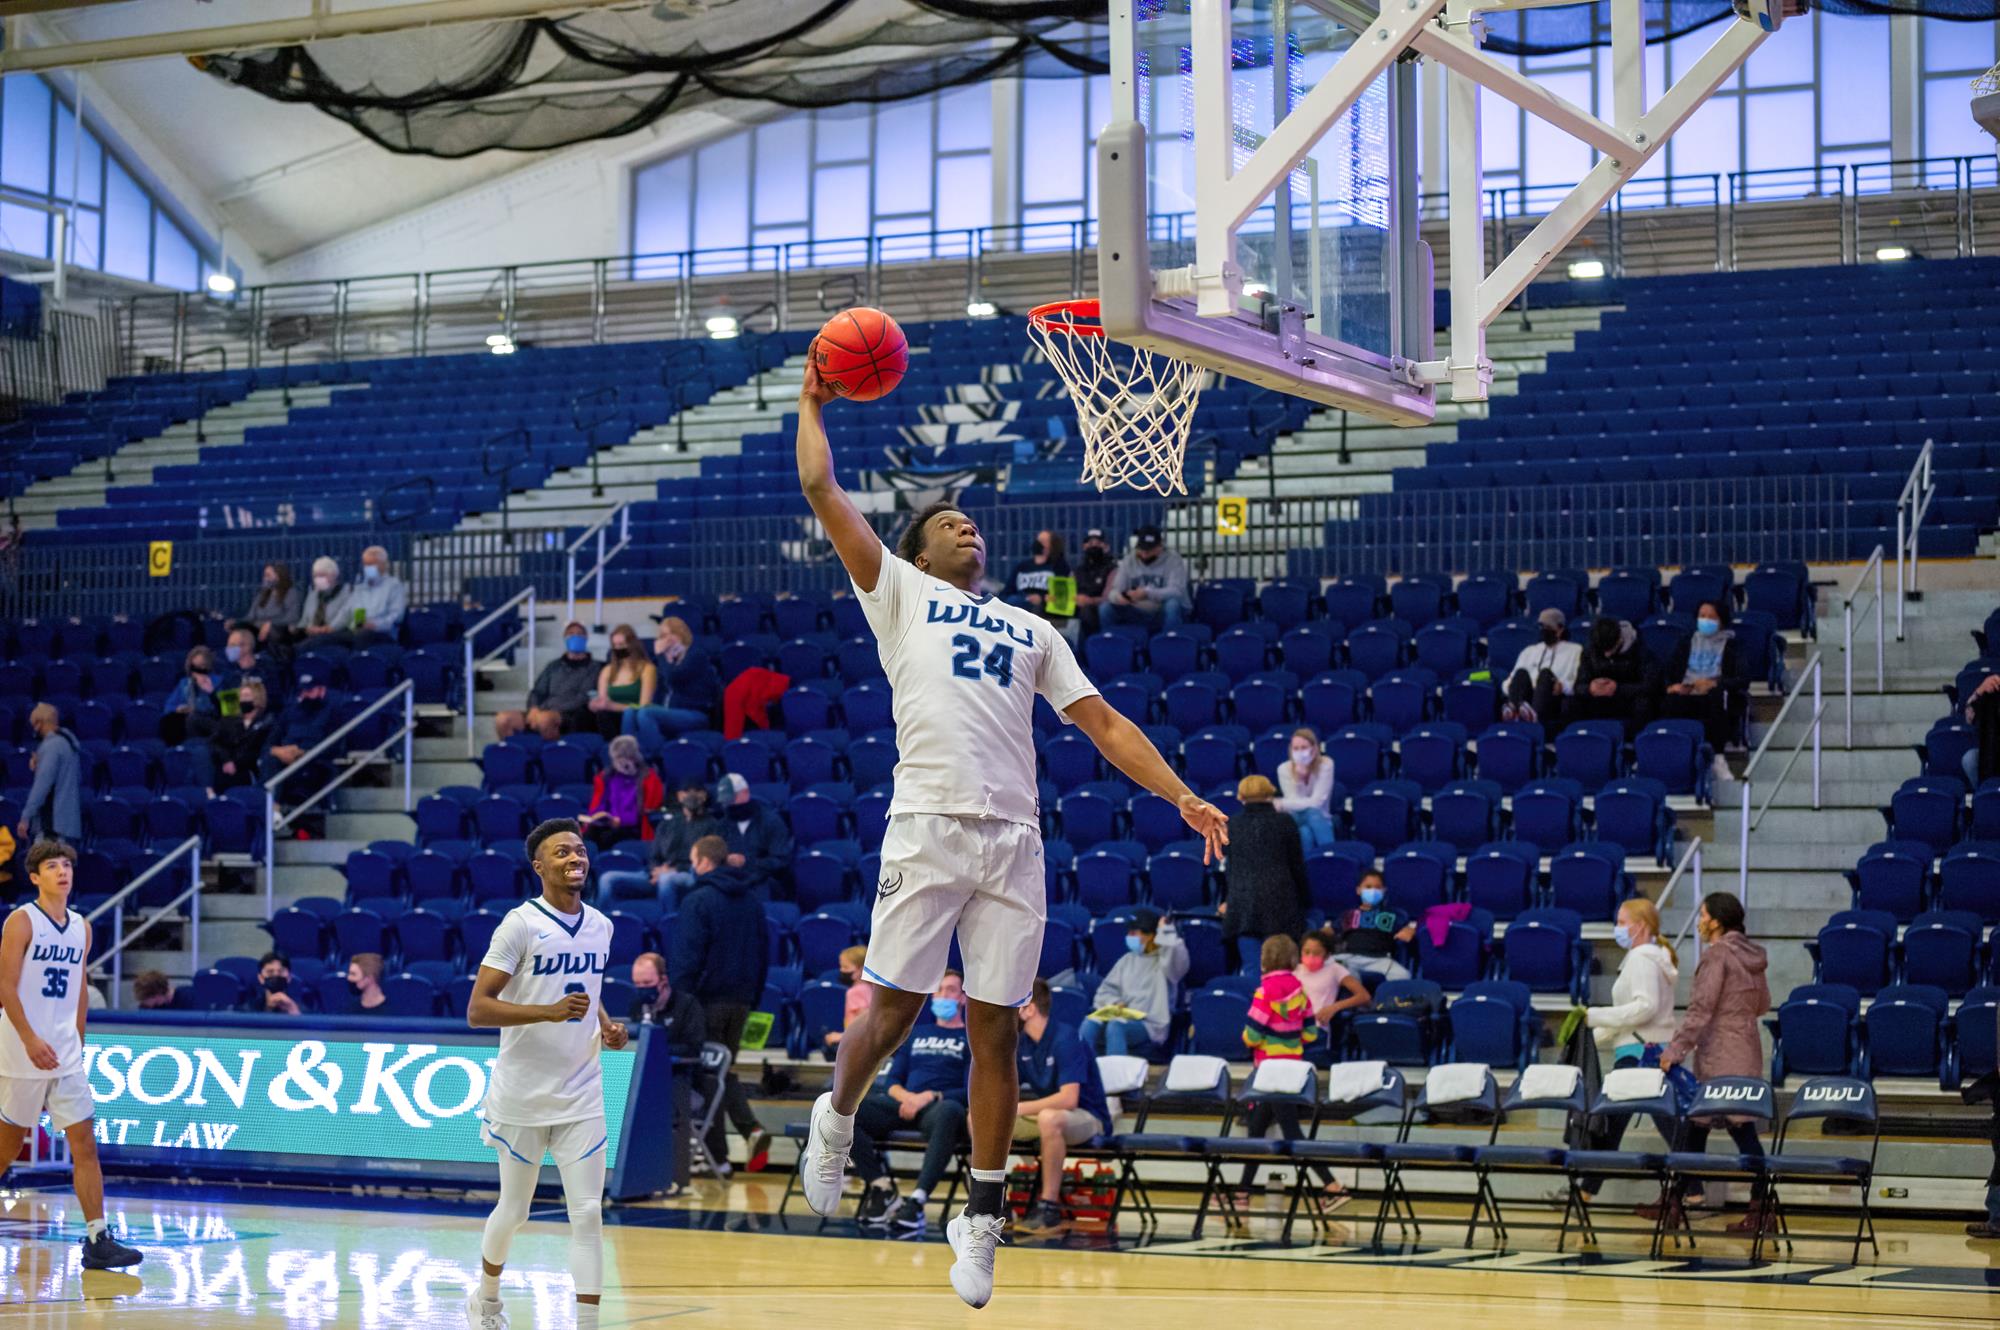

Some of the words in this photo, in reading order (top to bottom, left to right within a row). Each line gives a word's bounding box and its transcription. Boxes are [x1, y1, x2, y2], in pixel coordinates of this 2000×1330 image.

[1222, 503, 1242, 528] B
[152, 547, 168, 570] C
[927, 600, 1034, 648] WWU
[952, 632, 1015, 689] 24
[32, 944, 83, 965] WWU
[532, 952, 607, 976] WWU
[41, 967, 69, 999] 35
[911, 1036, 965, 1052] WWU
[267, 1040, 343, 1114] &
[350, 1043, 497, 1128] KO
[1703, 1085, 1765, 1101] WWU
[1803, 1086, 1865, 1101] WWU
[93, 1118, 139, 1145] AT
[151, 1120, 239, 1150] LAW
